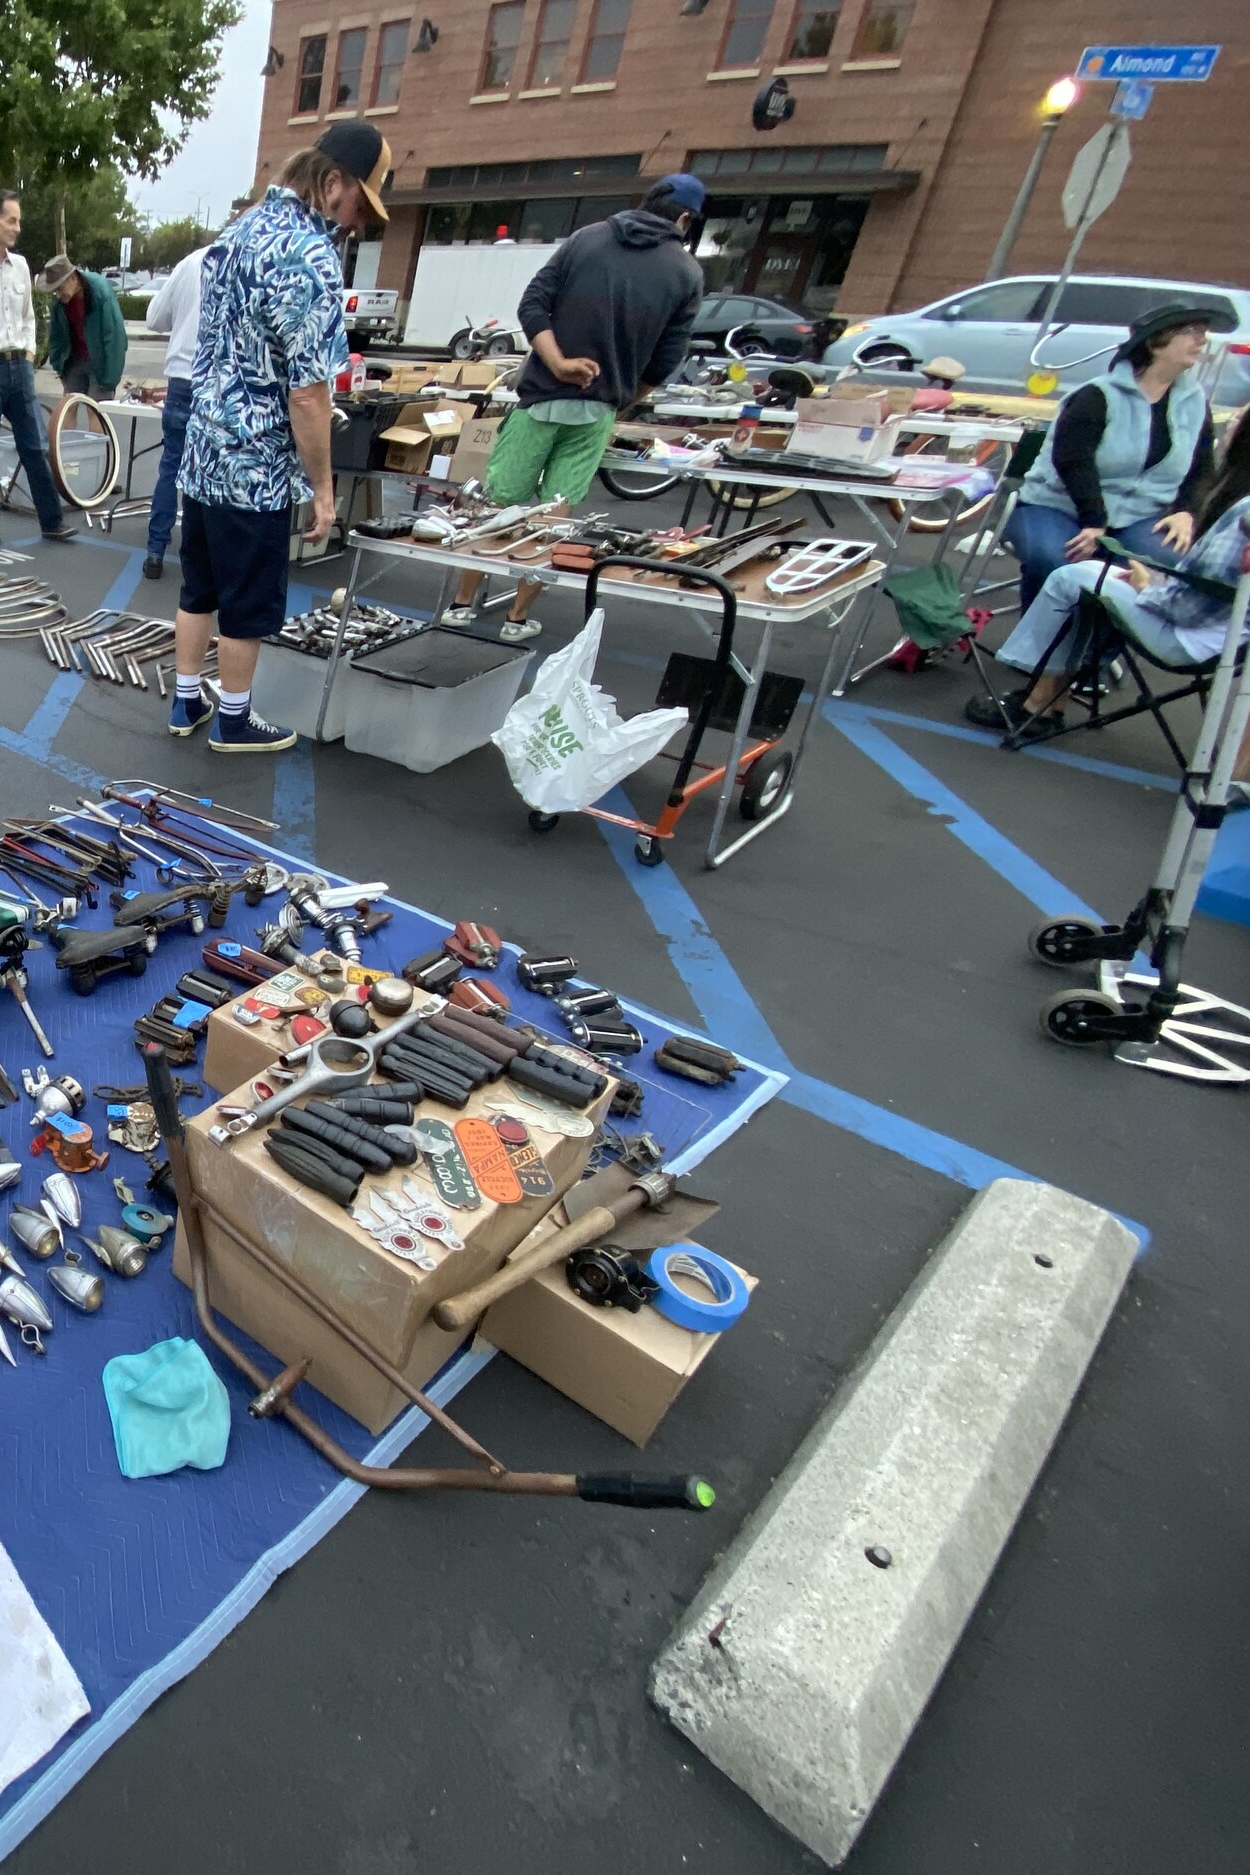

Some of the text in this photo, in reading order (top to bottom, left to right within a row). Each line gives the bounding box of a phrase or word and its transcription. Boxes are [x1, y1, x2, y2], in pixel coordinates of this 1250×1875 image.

[1109, 54, 1176, 73] Almond
[473, 429, 492, 445] Z13
[571, 681, 599, 729] SPROUTS
[473, 1149, 506, 1174] NAMPA
[521, 1177, 546, 1186] 914
